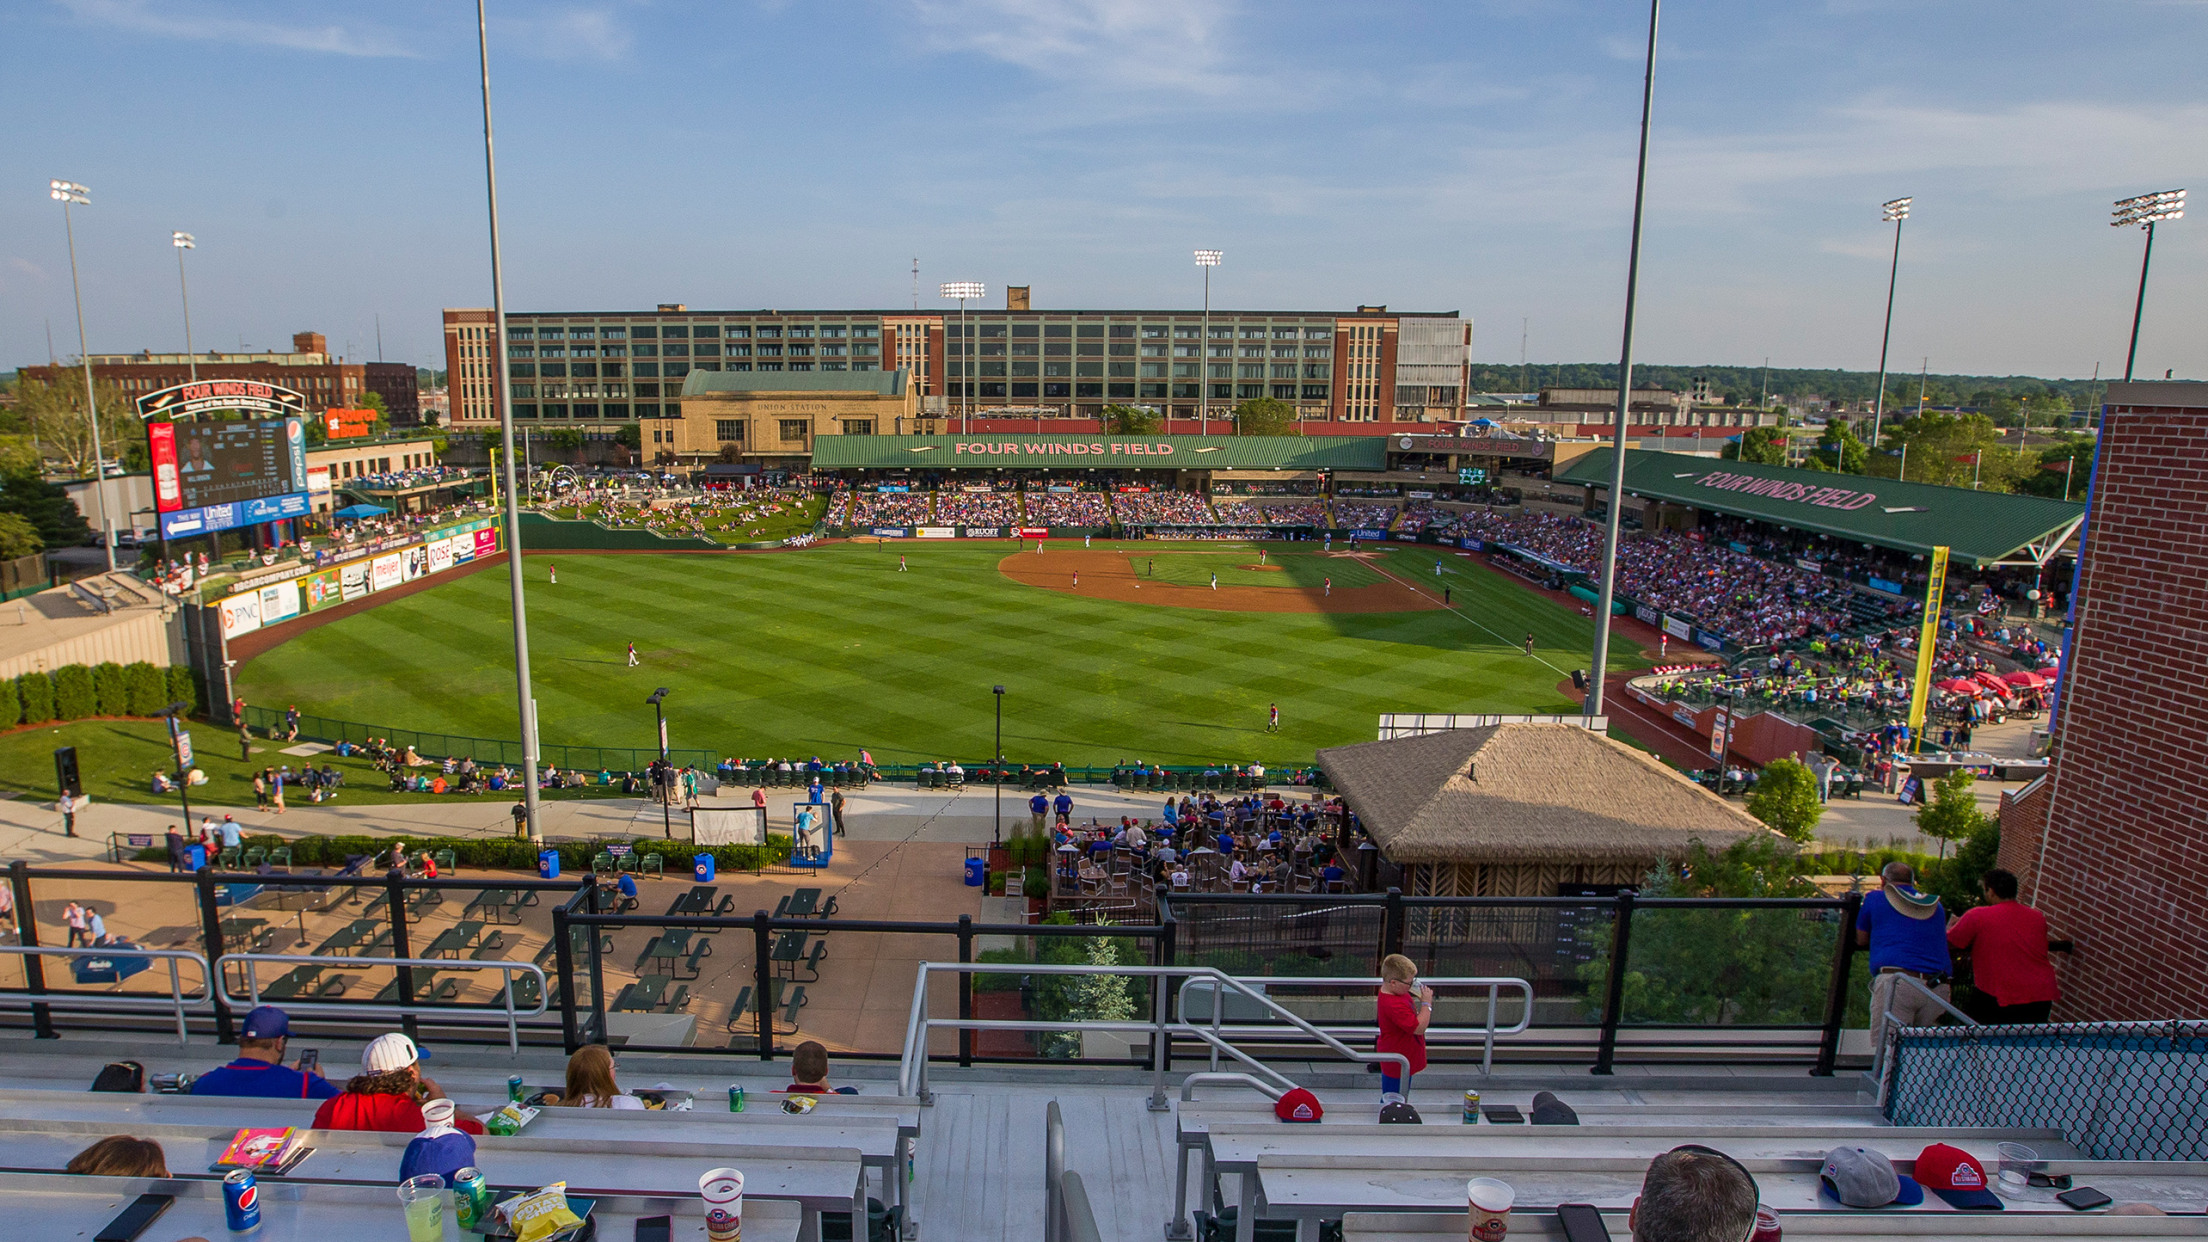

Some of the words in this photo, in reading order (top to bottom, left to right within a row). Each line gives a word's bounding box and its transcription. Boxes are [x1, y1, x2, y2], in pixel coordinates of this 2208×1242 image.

[182, 384, 212, 401] FOUR
[212, 382, 247, 396] WINDS
[248, 382, 274, 399] FIELD
[184, 401, 204, 412] Home
[223, 398, 239, 407] South
[757, 403, 786, 411] UNION
[790, 403, 828, 411] STATION
[338, 408, 377, 423] Source
[339, 421, 369, 438] Bank
[955, 443, 1019, 455] FOUR
[1024, 443, 1104, 455] WINDS
[1110, 443, 1174, 455] FIELD
[1428, 440, 1454, 449] FOUR
[1459, 441, 1490, 451] WINDS
[1496, 442, 1520, 452] FIELD
[292, 446, 305, 488] pepsi
[1694, 471, 1754, 493] FOUR
[1747, 477, 1817, 501] WINDS
[1800, 487, 1877, 510] FIELD
[203, 503, 233, 520] United
[1357, 529, 1380, 538] United
[1465, 539, 1480, 549] United
[429, 544, 450, 568] ROSE
[375, 560, 399, 577] meijer
[235, 603, 258, 623] PNC
[525, 1201, 566, 1221] CHIPS
